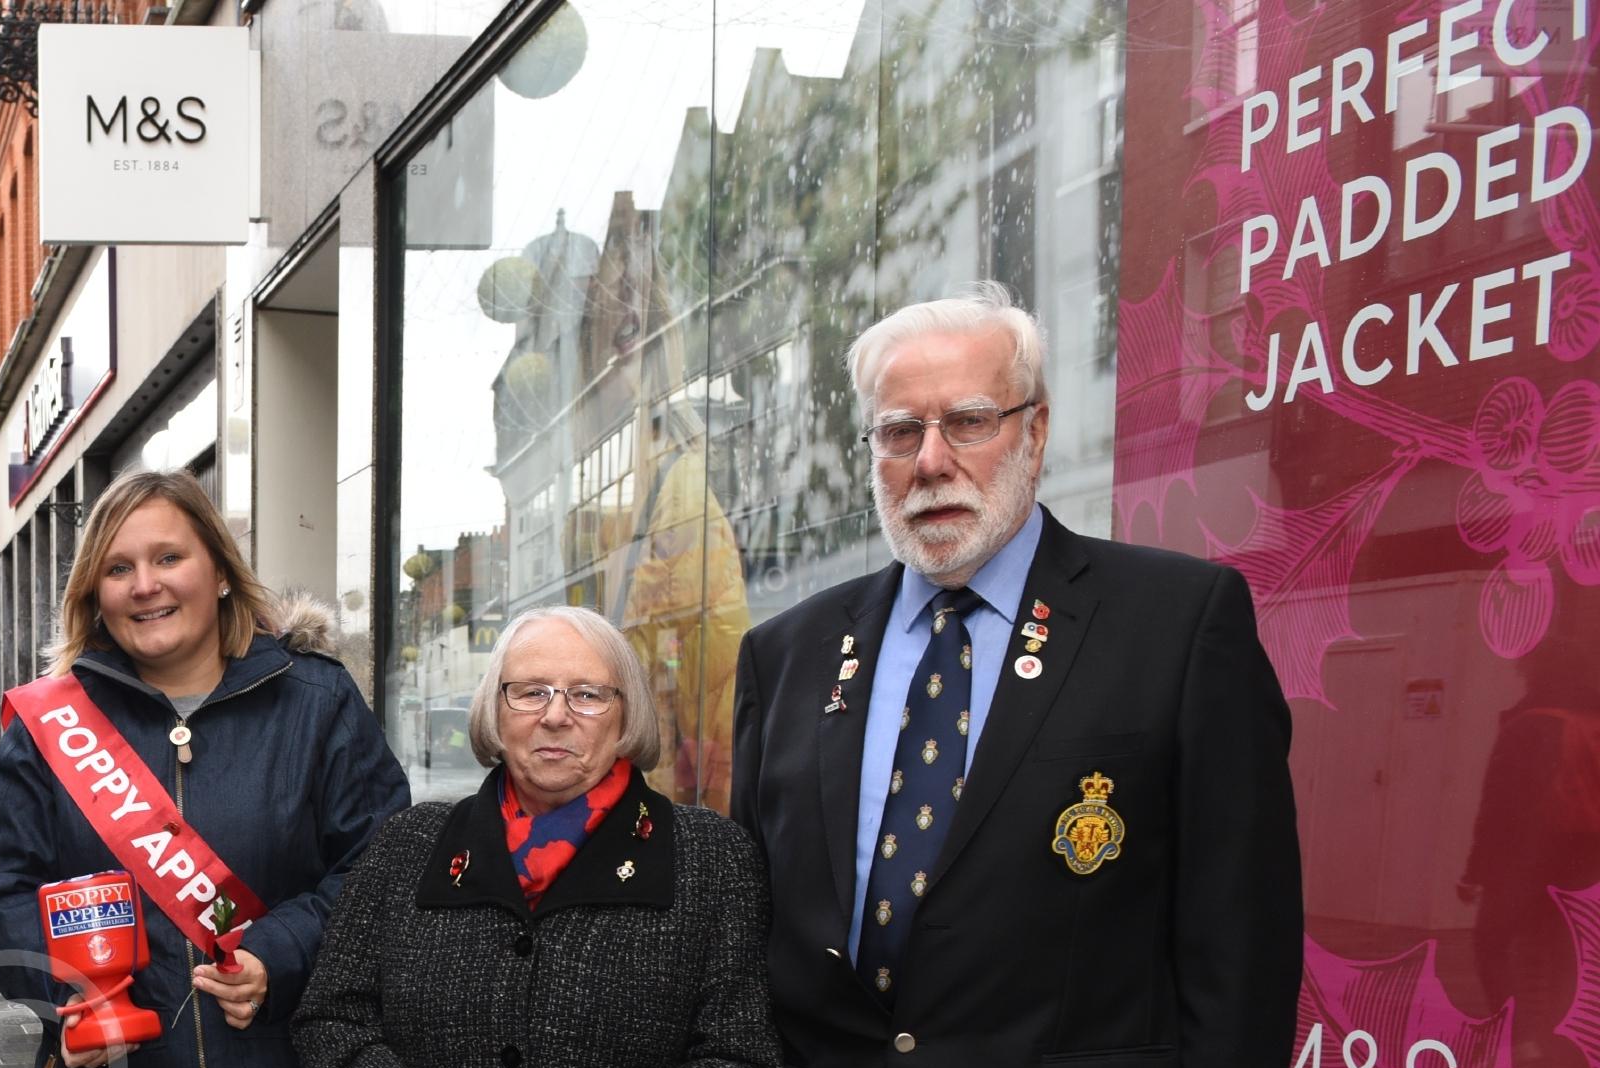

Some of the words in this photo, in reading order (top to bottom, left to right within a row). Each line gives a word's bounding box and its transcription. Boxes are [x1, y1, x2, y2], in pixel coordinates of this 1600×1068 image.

[86, 95, 206, 144] M&S
[113, 160, 143, 171] EST.
[147, 160, 180, 171] 1884
[1240, 106, 1591, 294] PADDED
[1244, 252, 1571, 411] JACKET
[39, 704, 151, 821] POPPY
[54, 885, 124, 911] POPPY
[57, 902, 129, 926] APPEAL
